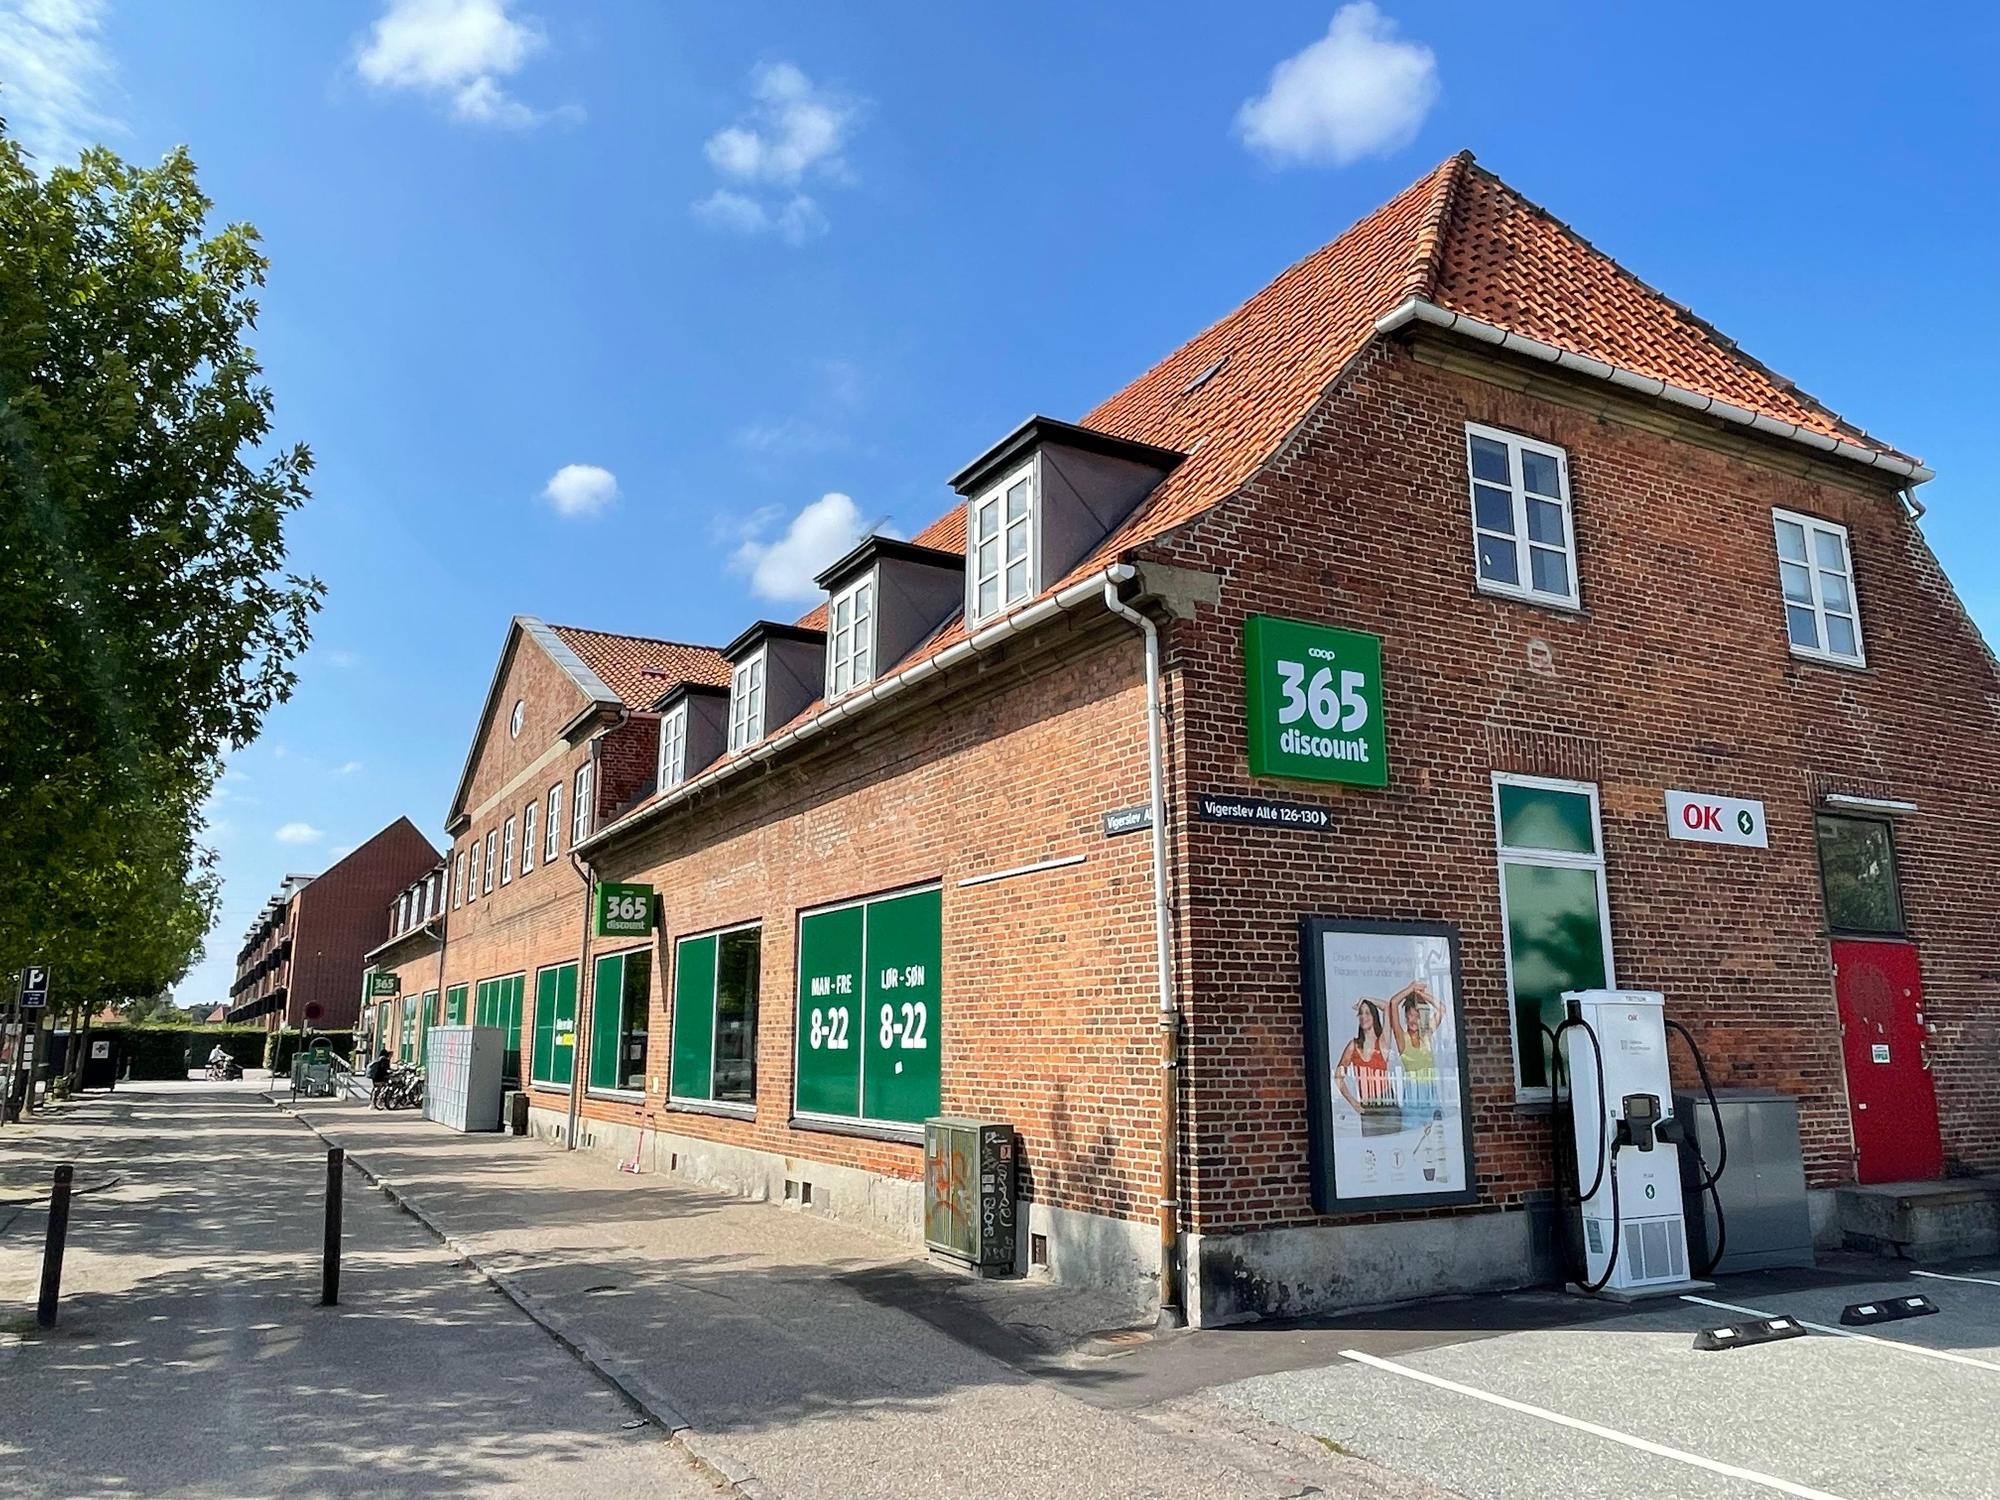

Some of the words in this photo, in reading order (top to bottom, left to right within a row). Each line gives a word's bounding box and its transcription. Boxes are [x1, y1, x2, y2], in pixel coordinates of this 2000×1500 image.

[1308, 647, 1336, 661] coop
[1277, 660, 1368, 732] 365
[1280, 729, 1369, 762] discount
[1107, 812, 1141, 831] Vigerslev
[1205, 801, 1254, 818] Vigerslev
[1256, 806, 1278, 820] Allé
[1280, 808, 1320, 824] 126-130
[1683, 803, 1723, 832] OK
[606, 896, 647, 920] 365
[374, 978, 394, 989] 365
[810, 1006, 849, 1050] 8-22
[880, 1001, 927, 1050] 8-22
